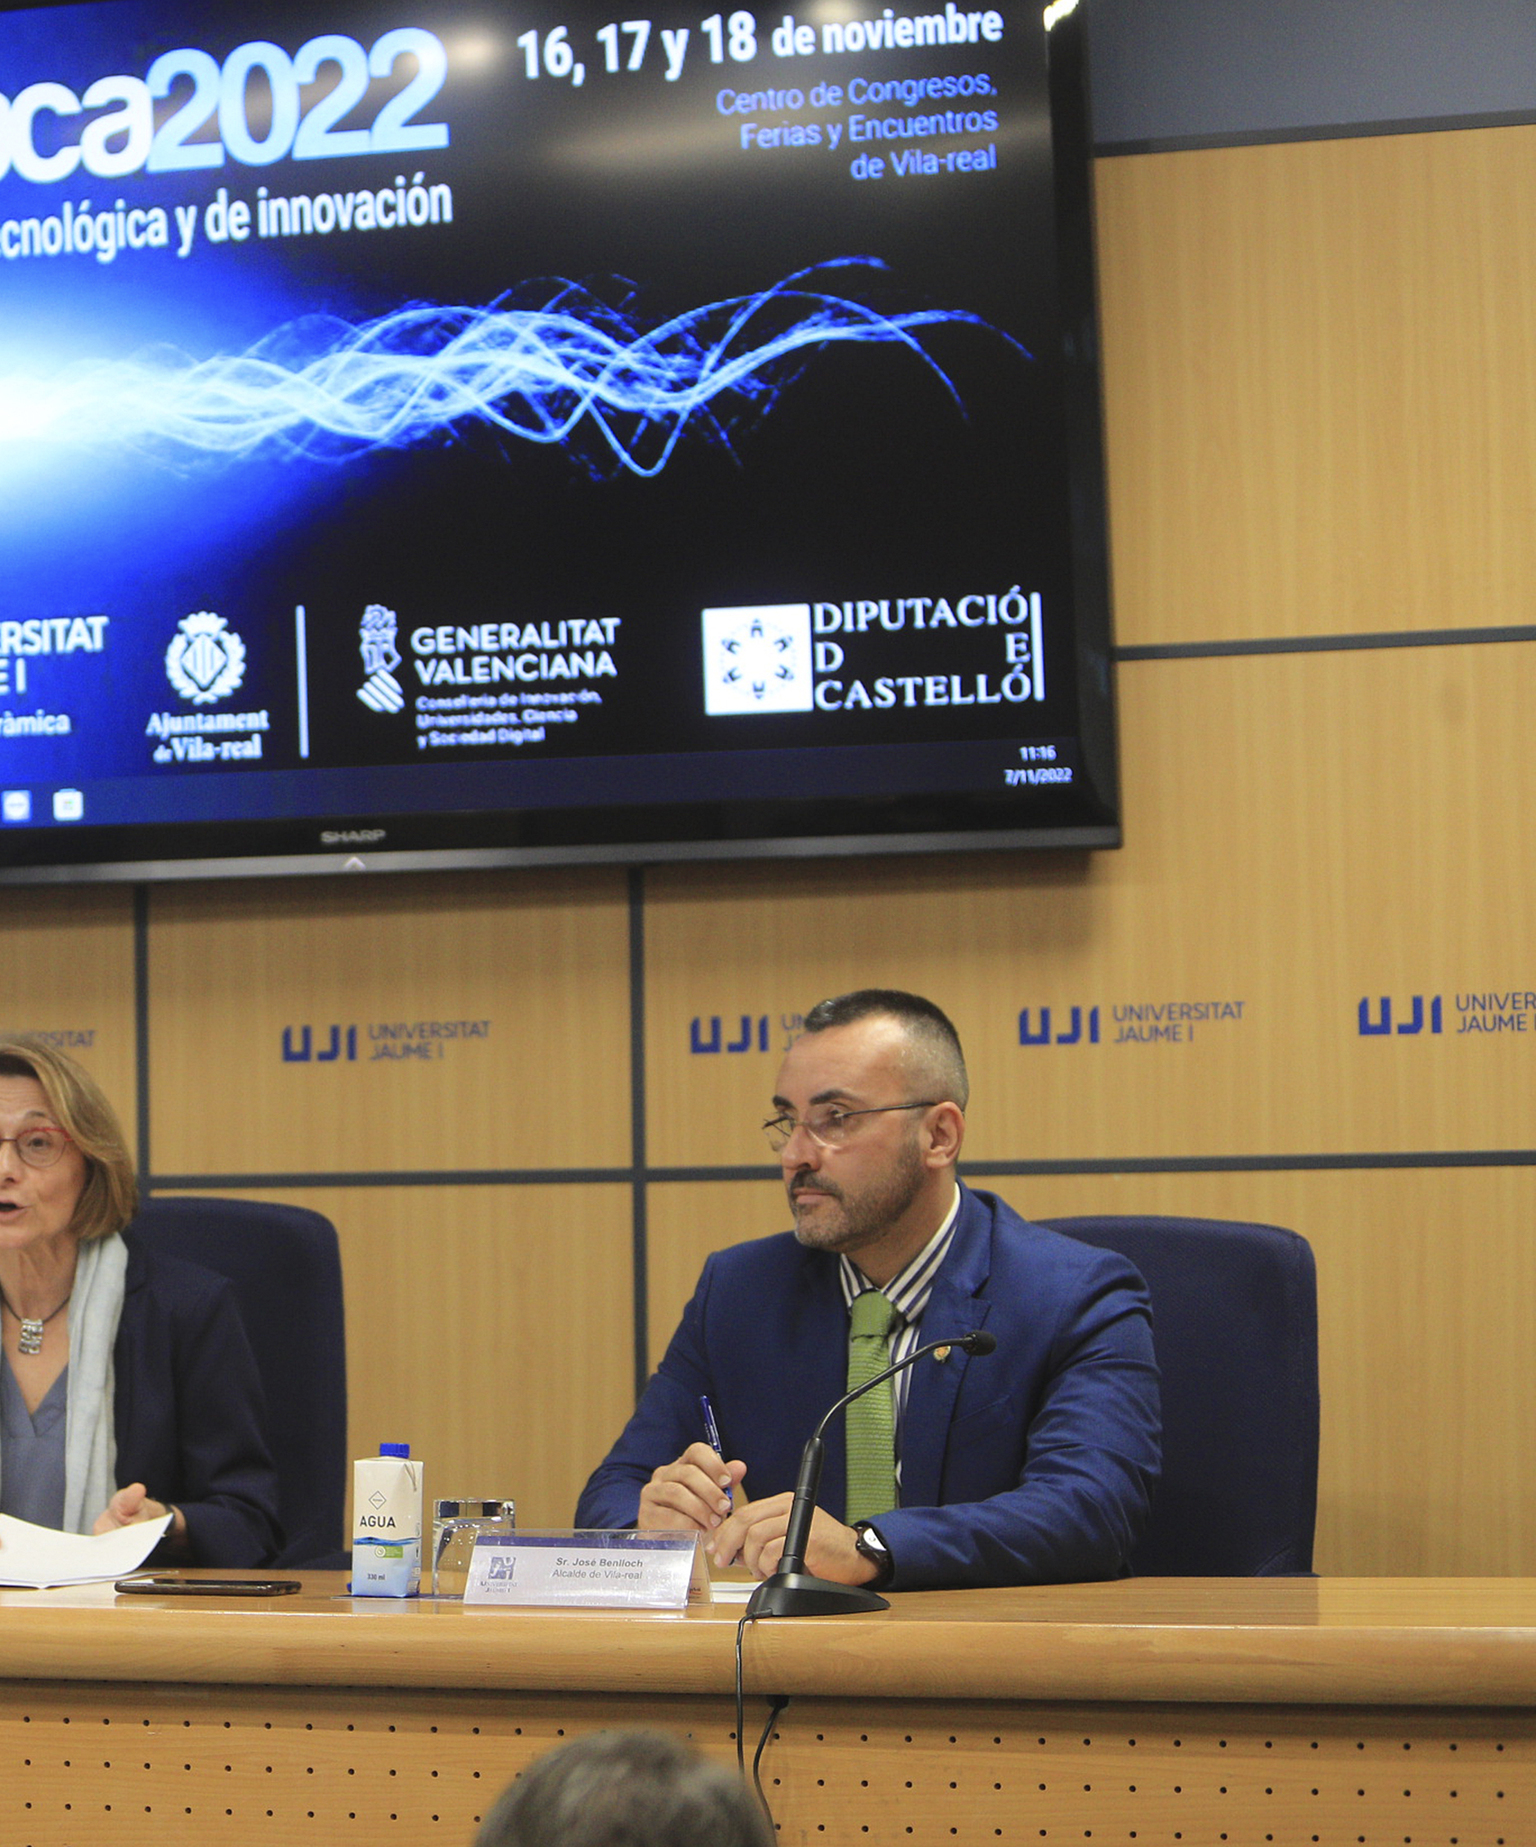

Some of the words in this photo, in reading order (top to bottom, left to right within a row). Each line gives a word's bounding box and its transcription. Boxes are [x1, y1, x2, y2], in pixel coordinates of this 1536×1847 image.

[517, 25, 585, 86] 16,
[597, 20, 651, 73] 17
[662, 28, 689, 81] y
[701, 11, 757, 63] 18
[772, 15, 816, 57] de
[823, 4, 1003, 54] noviembre
[716, 80, 801, 115] Centro
[810, 81, 842, 107] de
[741, 120, 821, 149] Ferias
[827, 122, 842, 149] y
[849, 110, 998, 142] Encuentros
[851, 153, 885, 180] de
[890, 144, 996, 176] Vila-real
[177, 206, 196, 256] y
[204, 190, 249, 242] de
[258, 171, 452, 237] innovación
[812, 585, 1031, 634] DIPUTACIÓ
[410, 617, 620, 656] GENERALITAT
[814, 640, 844, 673] D
[1005, 630, 1031, 665] E
[16, 659, 26, 695] I
[414, 651, 617, 686] VALENCIANA
[498, 692, 518, 708] de
[814, 671, 1032, 710] CASTELLÓ
[146, 709, 269, 737] Ajuntament
[522, 708, 578, 724] Ciencia
[172, 735, 261, 761] Vila-real
[417, 735, 428, 749] y
[428, 728, 496, 746] Sociedad
[497, 726, 545, 746] Digital
[1020, 745, 1057, 761] 11:16
[1004, 767, 1073, 786] 7/11/2022
[320, 830, 386, 843] SHARP
[1019, 1005, 1100, 1045] UJI
[1113, 1001, 1244, 1024] UNIVERSITAT
[1358, 995, 1442, 1035] UJI
[1456, 1013, 1527, 1034] JAUME
[282, 1024, 358, 1063] UJI
[368, 1020, 490, 1041] UNIVERSITAT
[691, 1015, 769, 1053] UJI
[1114, 1024, 1180, 1043] JAUME
[1188, 1024, 1193, 1042] I
[369, 1042, 434, 1061] JAUME
[439, 1042, 444, 1059] I
[359, 1515, 396, 1528] AGUA
[552, 1570, 586, 1579] Alcalde
[590, 1570, 601, 1579] de
[604, 1570, 642, 1580] Vila-real
[556, 1557, 569, 1567] Sr.
[572, 1557, 596, 1567] José
[599, 1558, 643, 1568] Benlloch
